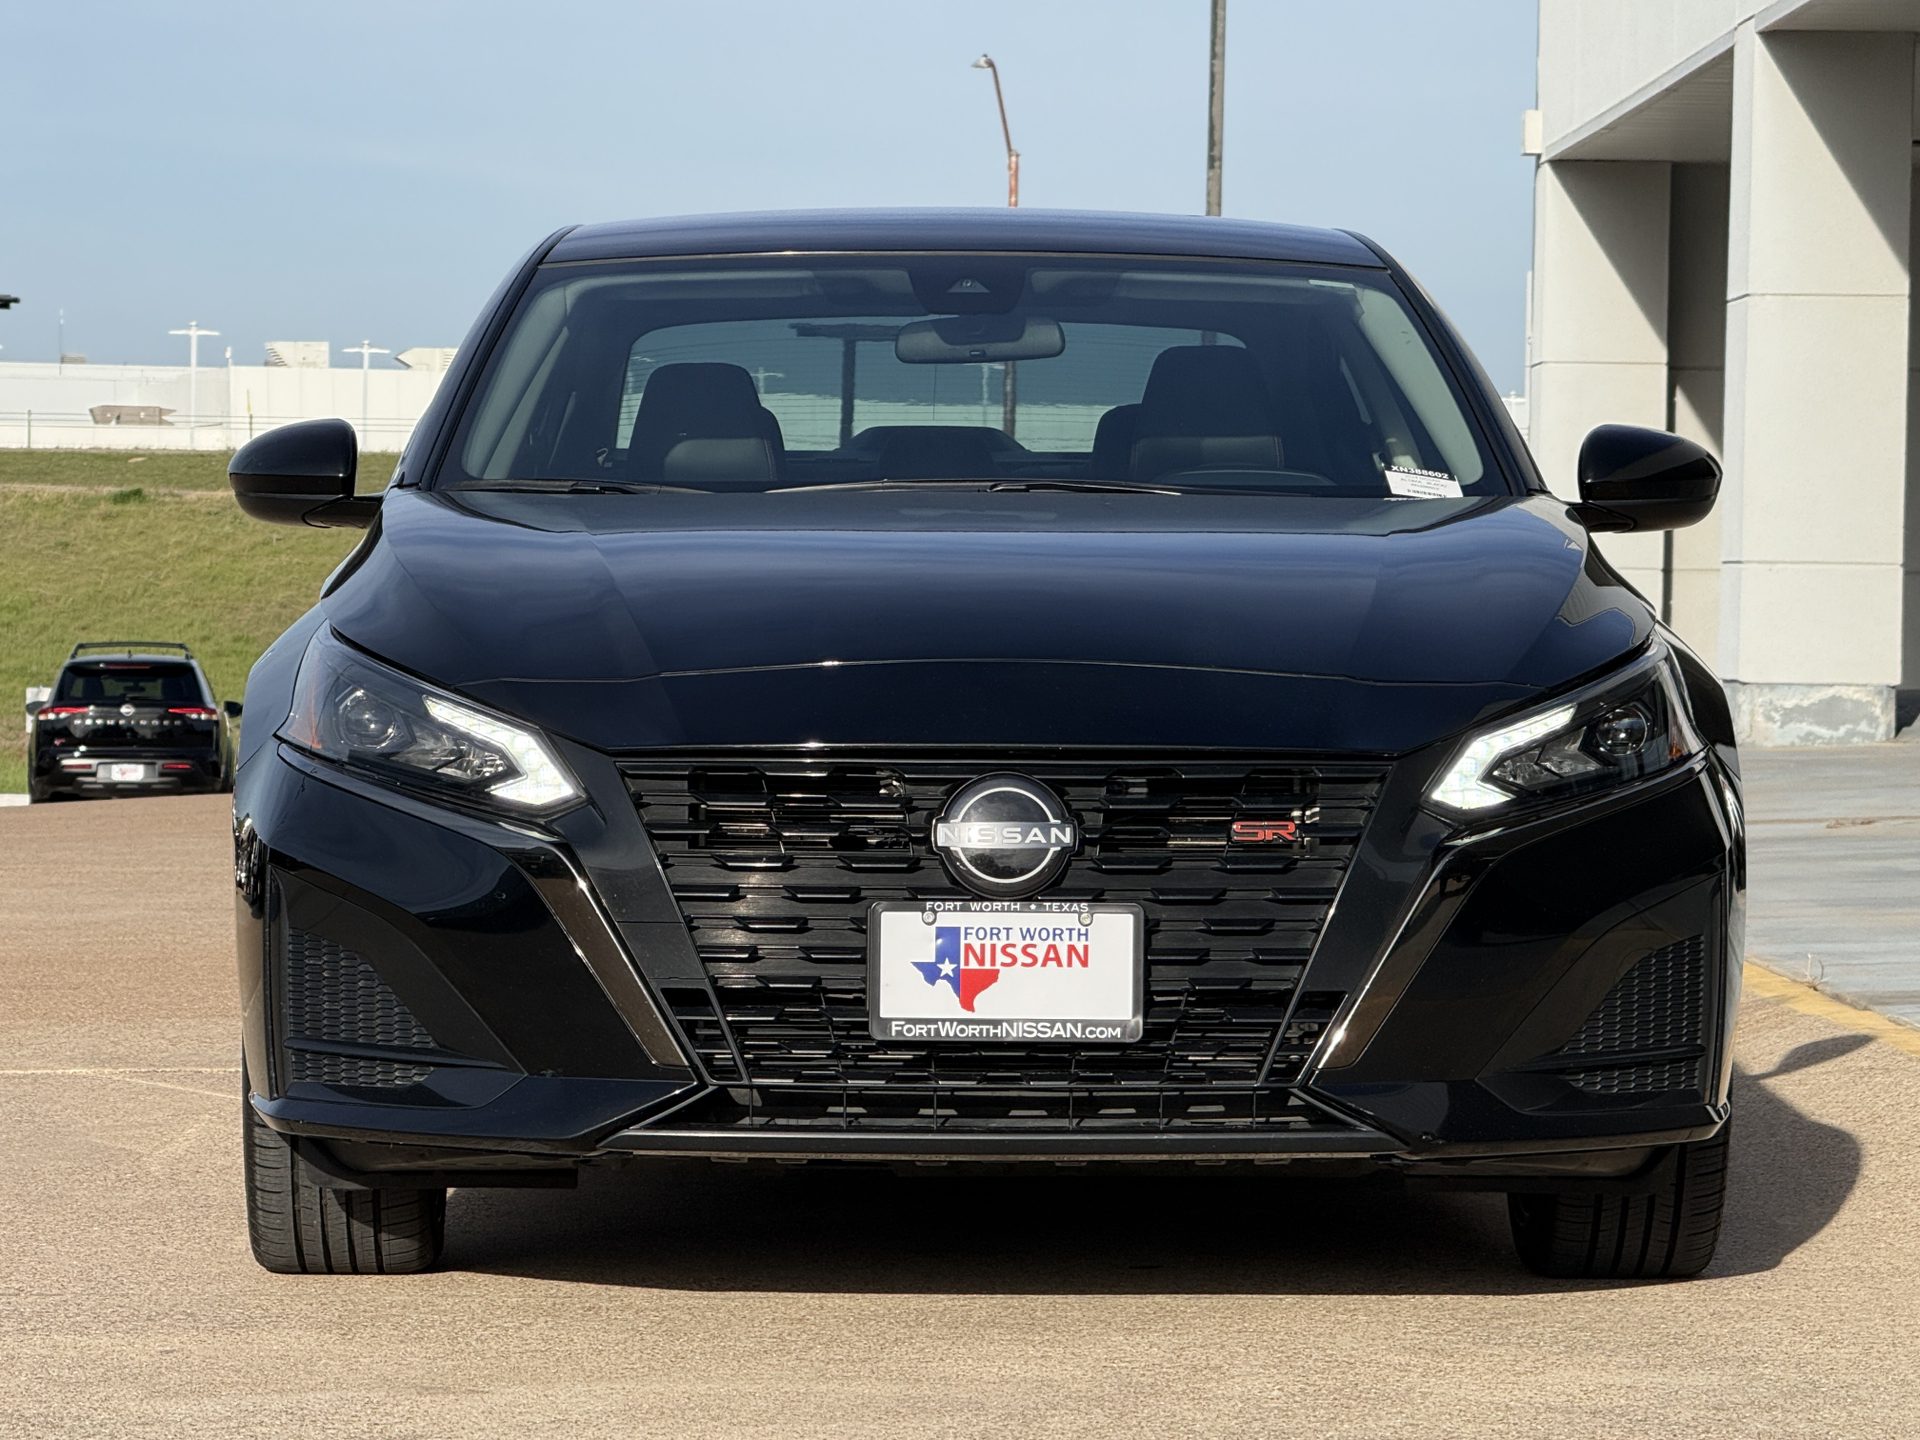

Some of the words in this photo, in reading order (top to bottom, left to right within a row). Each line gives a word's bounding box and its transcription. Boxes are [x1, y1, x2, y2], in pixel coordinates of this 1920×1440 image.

[1390, 465, 1450, 480] XN388602
[940, 826, 1071, 844] NISSAN
[1231, 821, 1297, 842] SR
[926, 902, 963, 911] FORT
[970, 902, 1021, 912] WORTH
[1043, 902, 1089, 912] TEXAS
[963, 926, 1013, 941] FORT
[1019, 927, 1089, 942] WORTH
[963, 943, 1089, 968] NISSAN
